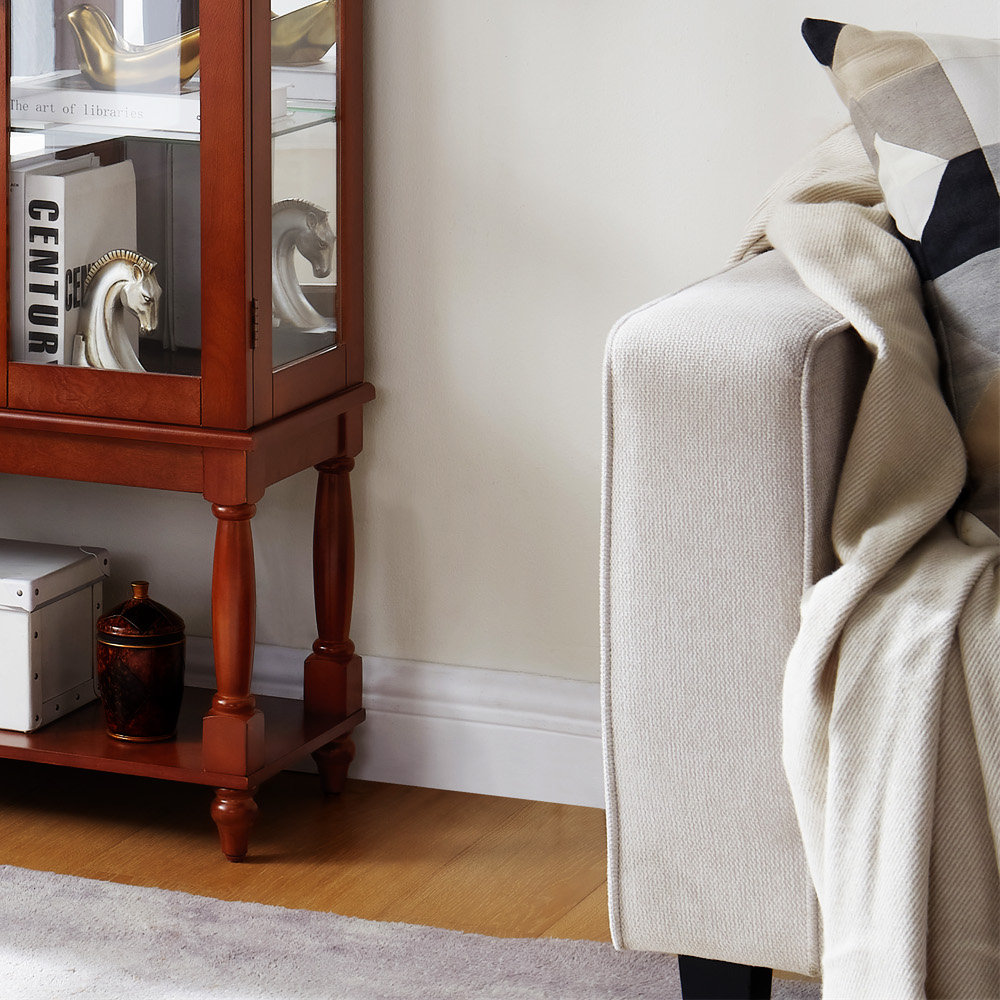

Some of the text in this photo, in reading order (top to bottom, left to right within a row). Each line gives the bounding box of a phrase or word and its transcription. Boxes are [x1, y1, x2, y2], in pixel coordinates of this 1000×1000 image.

[11, 99, 144, 119] The art of libraries
[28, 199, 59, 365] CENTUR
